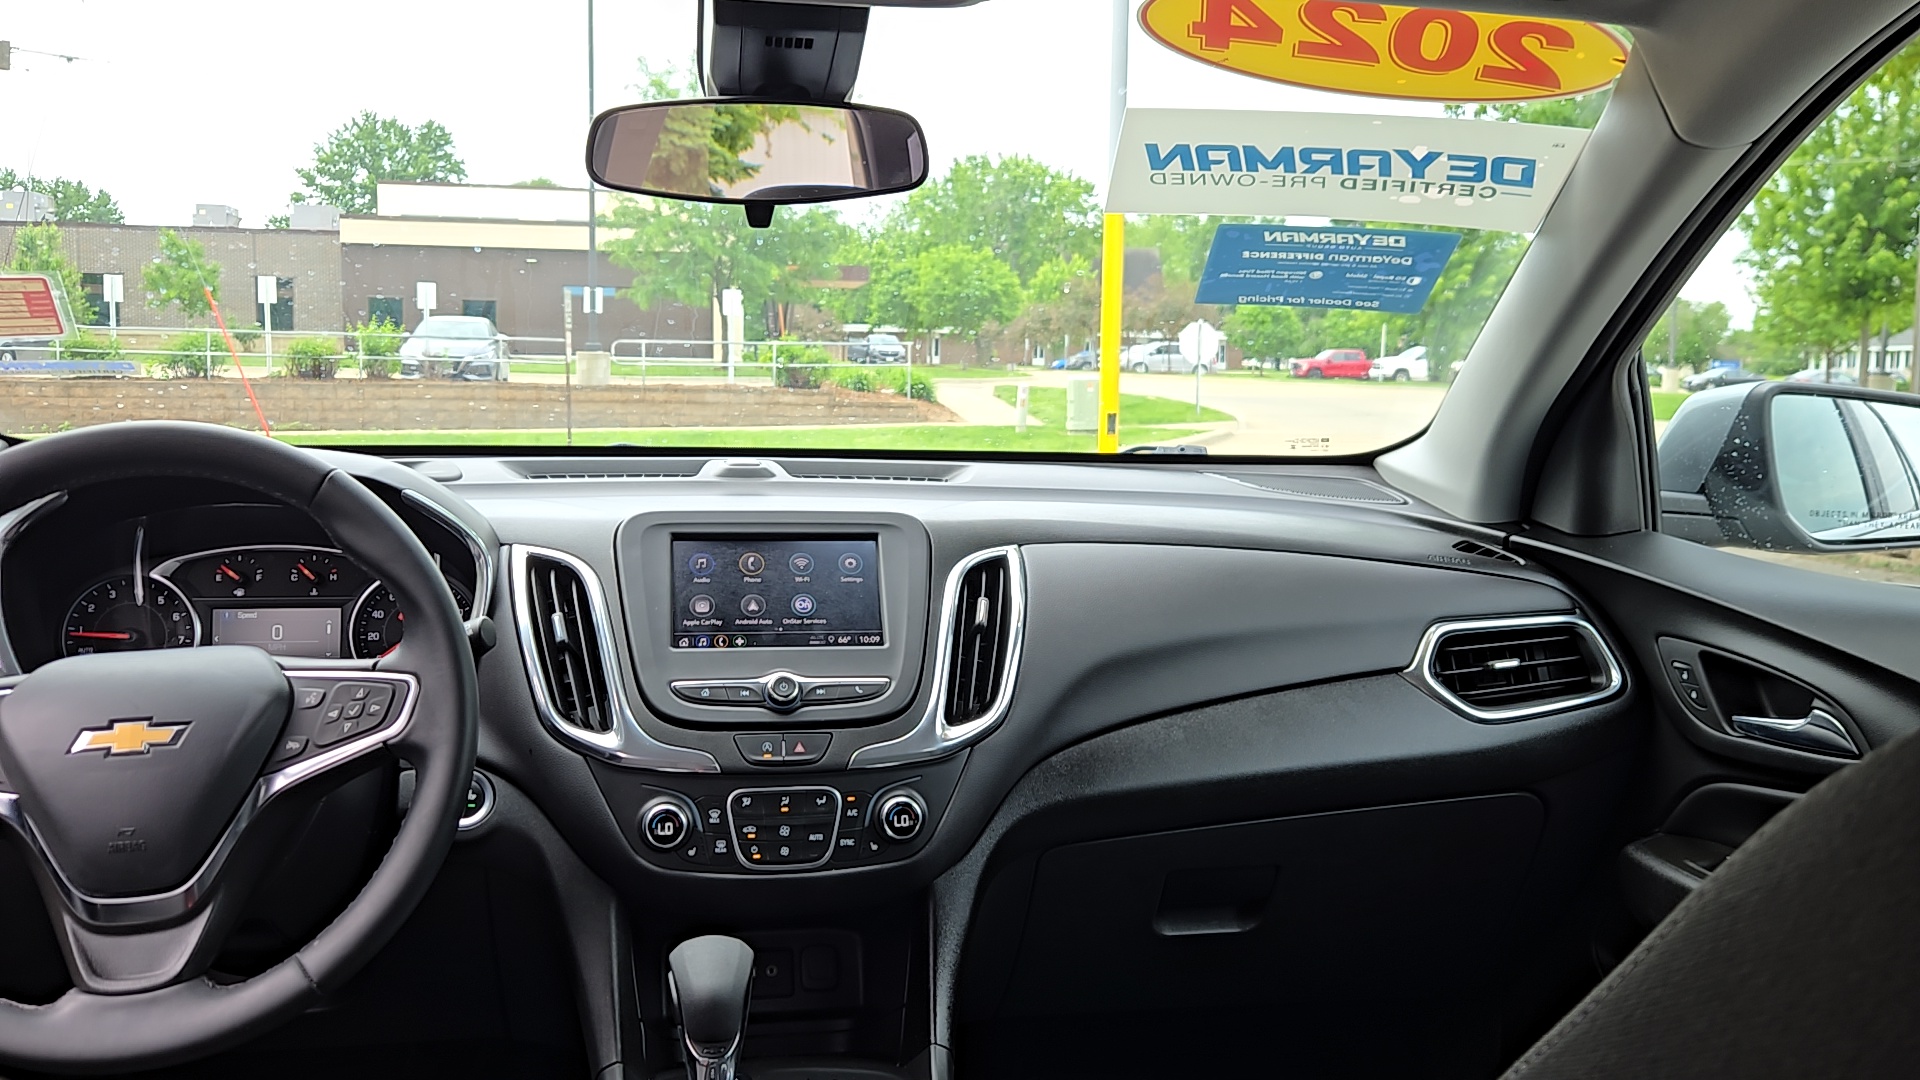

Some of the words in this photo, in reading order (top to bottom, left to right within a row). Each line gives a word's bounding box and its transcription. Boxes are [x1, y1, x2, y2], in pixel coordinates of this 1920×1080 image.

[330, 573, 337, 581] H
[109, 590, 117, 599] 3
[157, 596, 165, 605] 5
[87, 604, 95, 612] 2
[172, 612, 180, 621] 6
[237, 612, 257, 620] Speed
[371, 610, 385, 619] 40
[683, 619, 700, 627] Apple
[178, 636, 185, 645] 7
[367, 632, 380, 641] 20
[859, 635, 880, 643] 10:09
[847, 808, 858, 816] A/C
[894, 814, 909, 827] LO
[657, 821, 674, 836] LO
[808, 833, 824, 841] AUTO
[839, 838, 855, 847] SYNC
